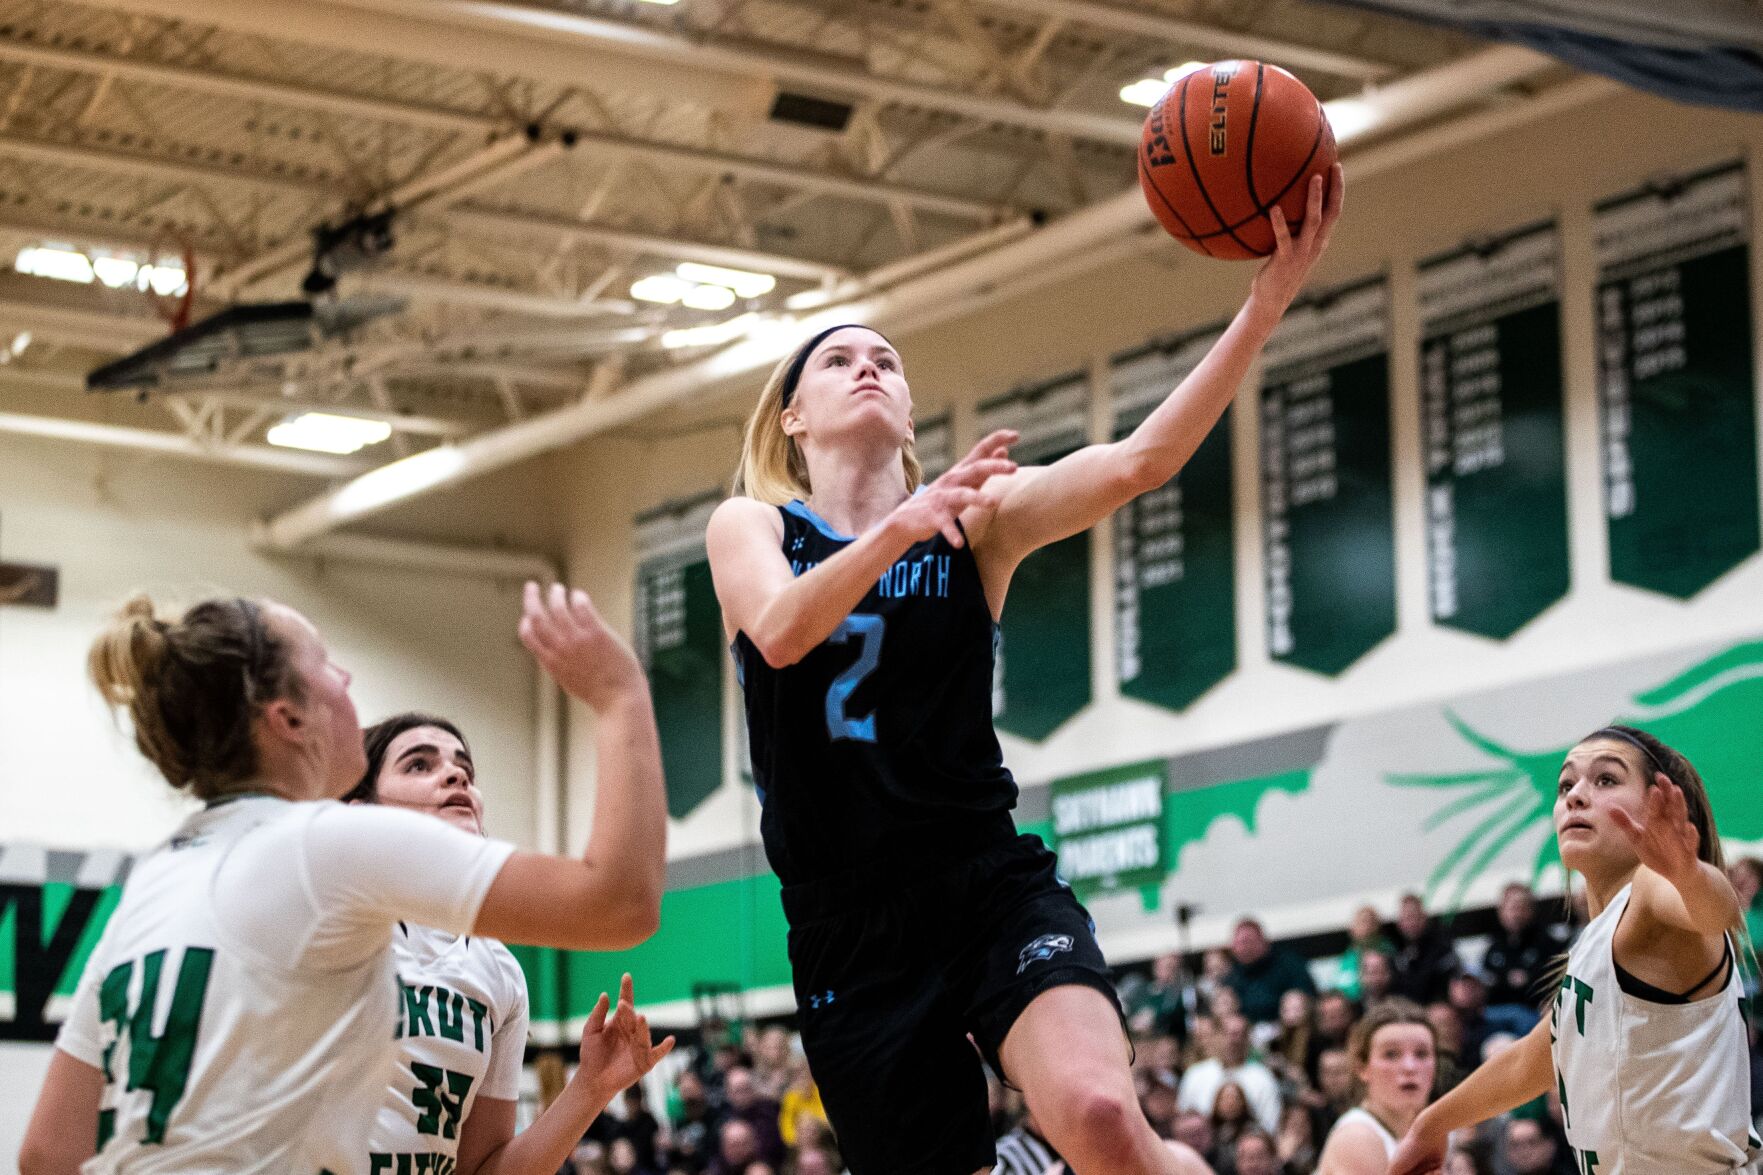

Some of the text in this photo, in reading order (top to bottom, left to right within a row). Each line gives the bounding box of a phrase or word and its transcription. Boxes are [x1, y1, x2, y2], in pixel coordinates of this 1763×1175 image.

[1209, 70, 1232, 156] ELITE
[878, 555, 951, 598] NORTH
[825, 614, 885, 742] 2
